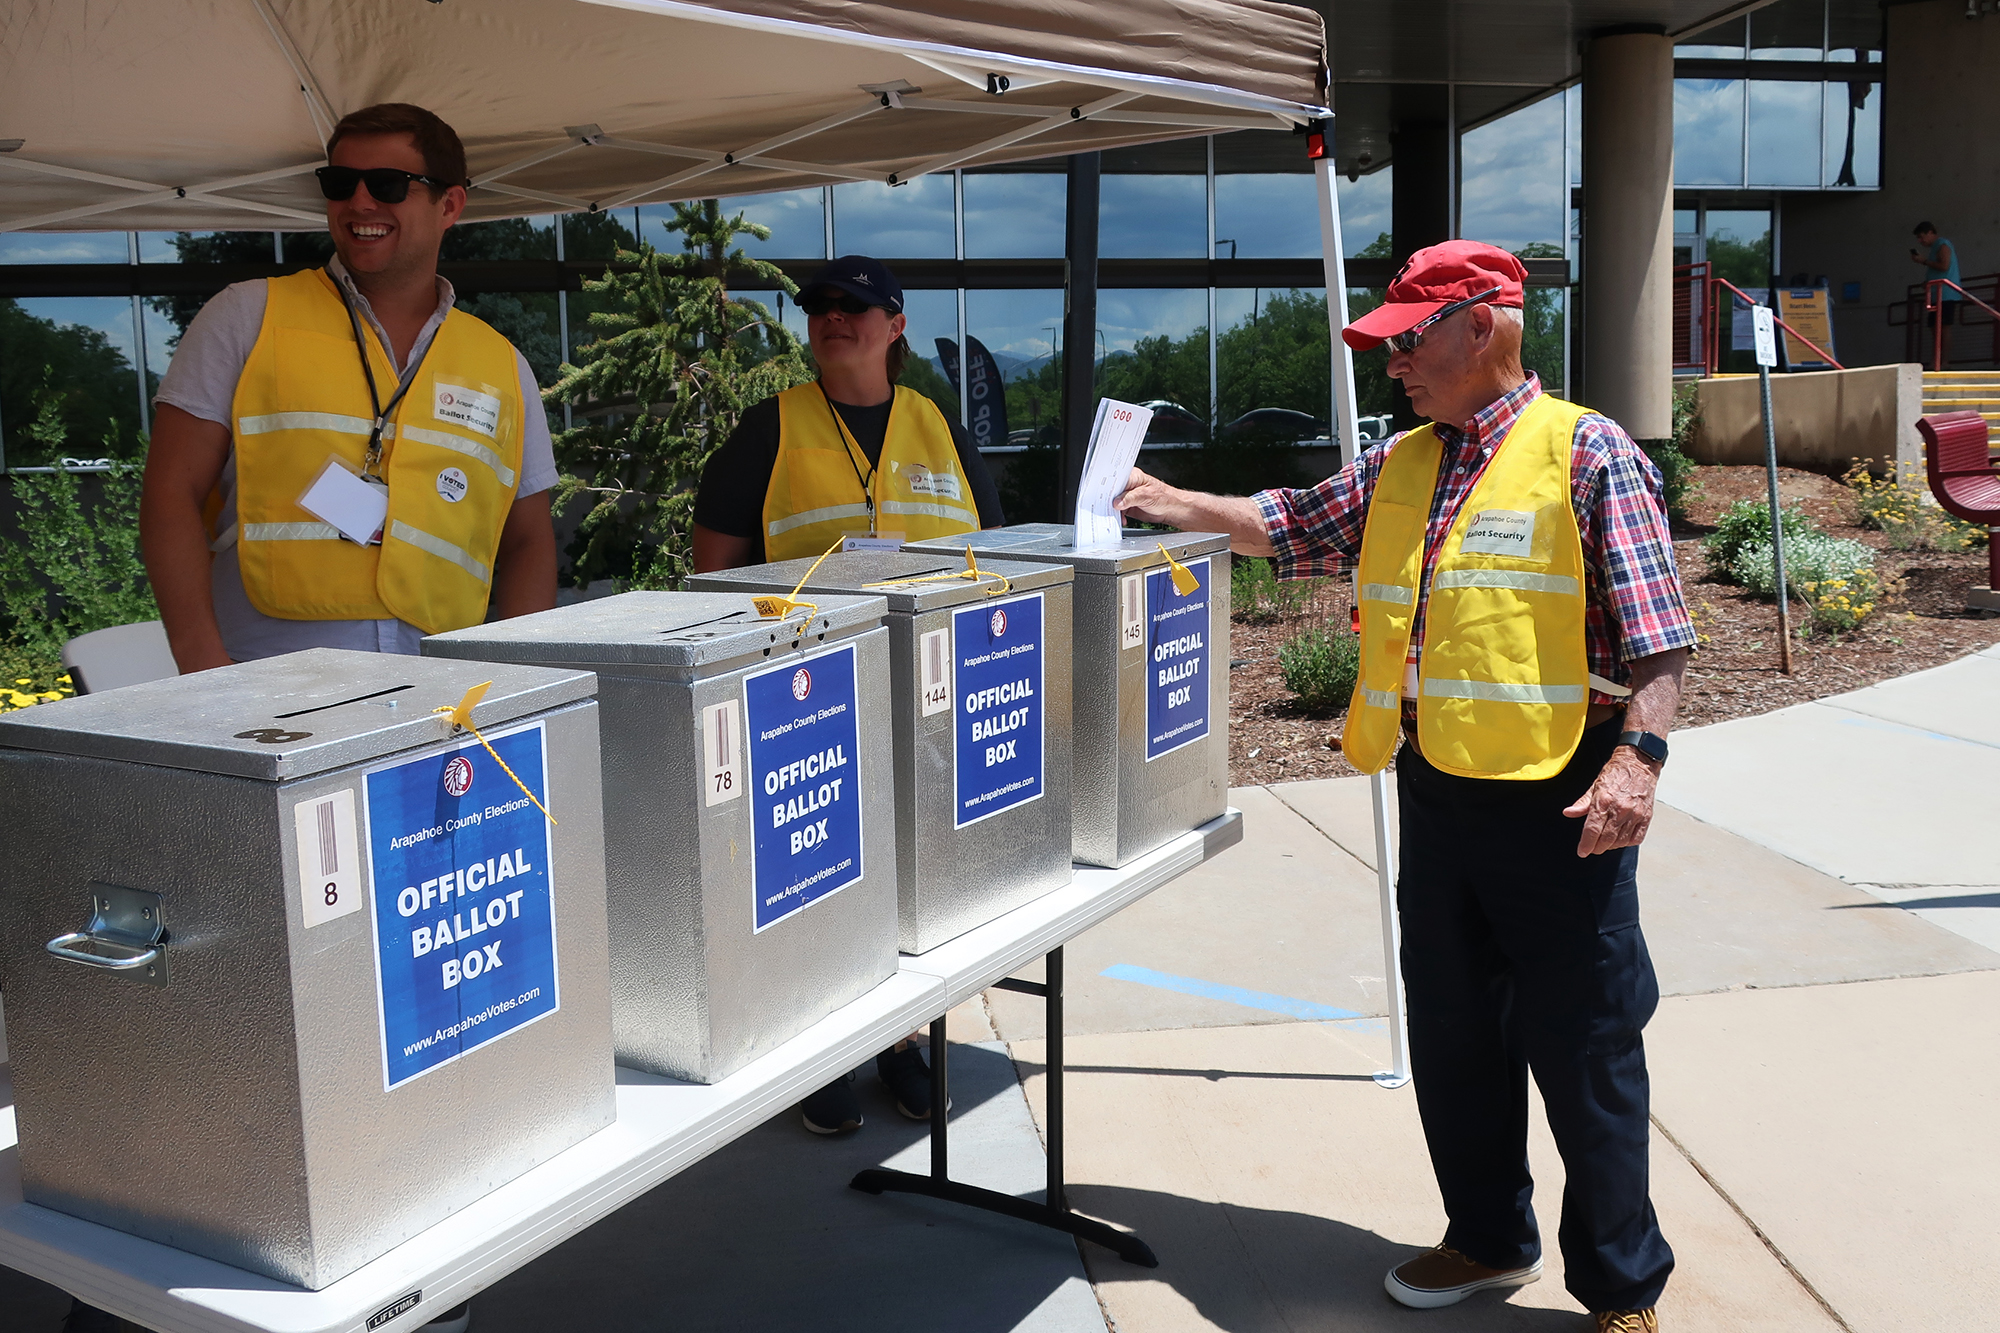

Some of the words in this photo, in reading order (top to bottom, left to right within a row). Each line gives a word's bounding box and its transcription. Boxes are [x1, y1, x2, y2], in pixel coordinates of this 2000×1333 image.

[439, 408, 465, 420] Ballot
[466, 415, 495, 432] Security
[444, 474, 465, 490] VOTED
[1487, 529, 1526, 542] Security
[1505, 516, 1527, 525] County
[1152, 610, 1172, 622] Arapahoe
[1172, 607, 1187, 617] County
[1187, 601, 1204, 612] Elections
[1124, 624, 1140, 641] 145
[1154, 632, 1203, 662] OFFICIAL
[963, 652, 991, 668] Arapahoe
[991, 647, 1011, 661] County
[1011, 643, 1035, 656] Elections
[1158, 657, 1200, 688] BALLOT
[925, 686, 946, 706] 144
[965, 678, 1034, 714] OFFICIAL
[1168, 685, 1191, 709] BOX
[760, 722, 793, 742] Arapahoe
[793, 713, 817, 728] County
[817, 703, 847, 720] Elections
[972, 706, 1030, 742] BALLOT
[1153, 718, 1204, 744] www.ArapahoeVotes.com
[985, 739, 1017, 768] BOX
[714, 770, 732, 793] 78
[764, 744, 848, 796] OFFICIAL
[772, 778, 843, 829] BALLOT
[964, 776, 1035, 808] www.ArapahoeVotes.com
[389, 825, 443, 851] Arapahoe
[445, 812, 483, 833] County
[484, 797, 530, 821] Elections
[790, 817, 829, 856] BOX
[324, 881, 339, 907] 8
[396, 848, 532, 918] OFFICIAL
[765, 857, 852, 907] www.ArapahoeVotes.com
[411, 890, 525, 959] BALLOT
[441, 940, 504, 991] BOX
[403, 986, 540, 1057] www.ArapahoeVotes.com
[374, 1296, 416, 1326] LIFETIME
